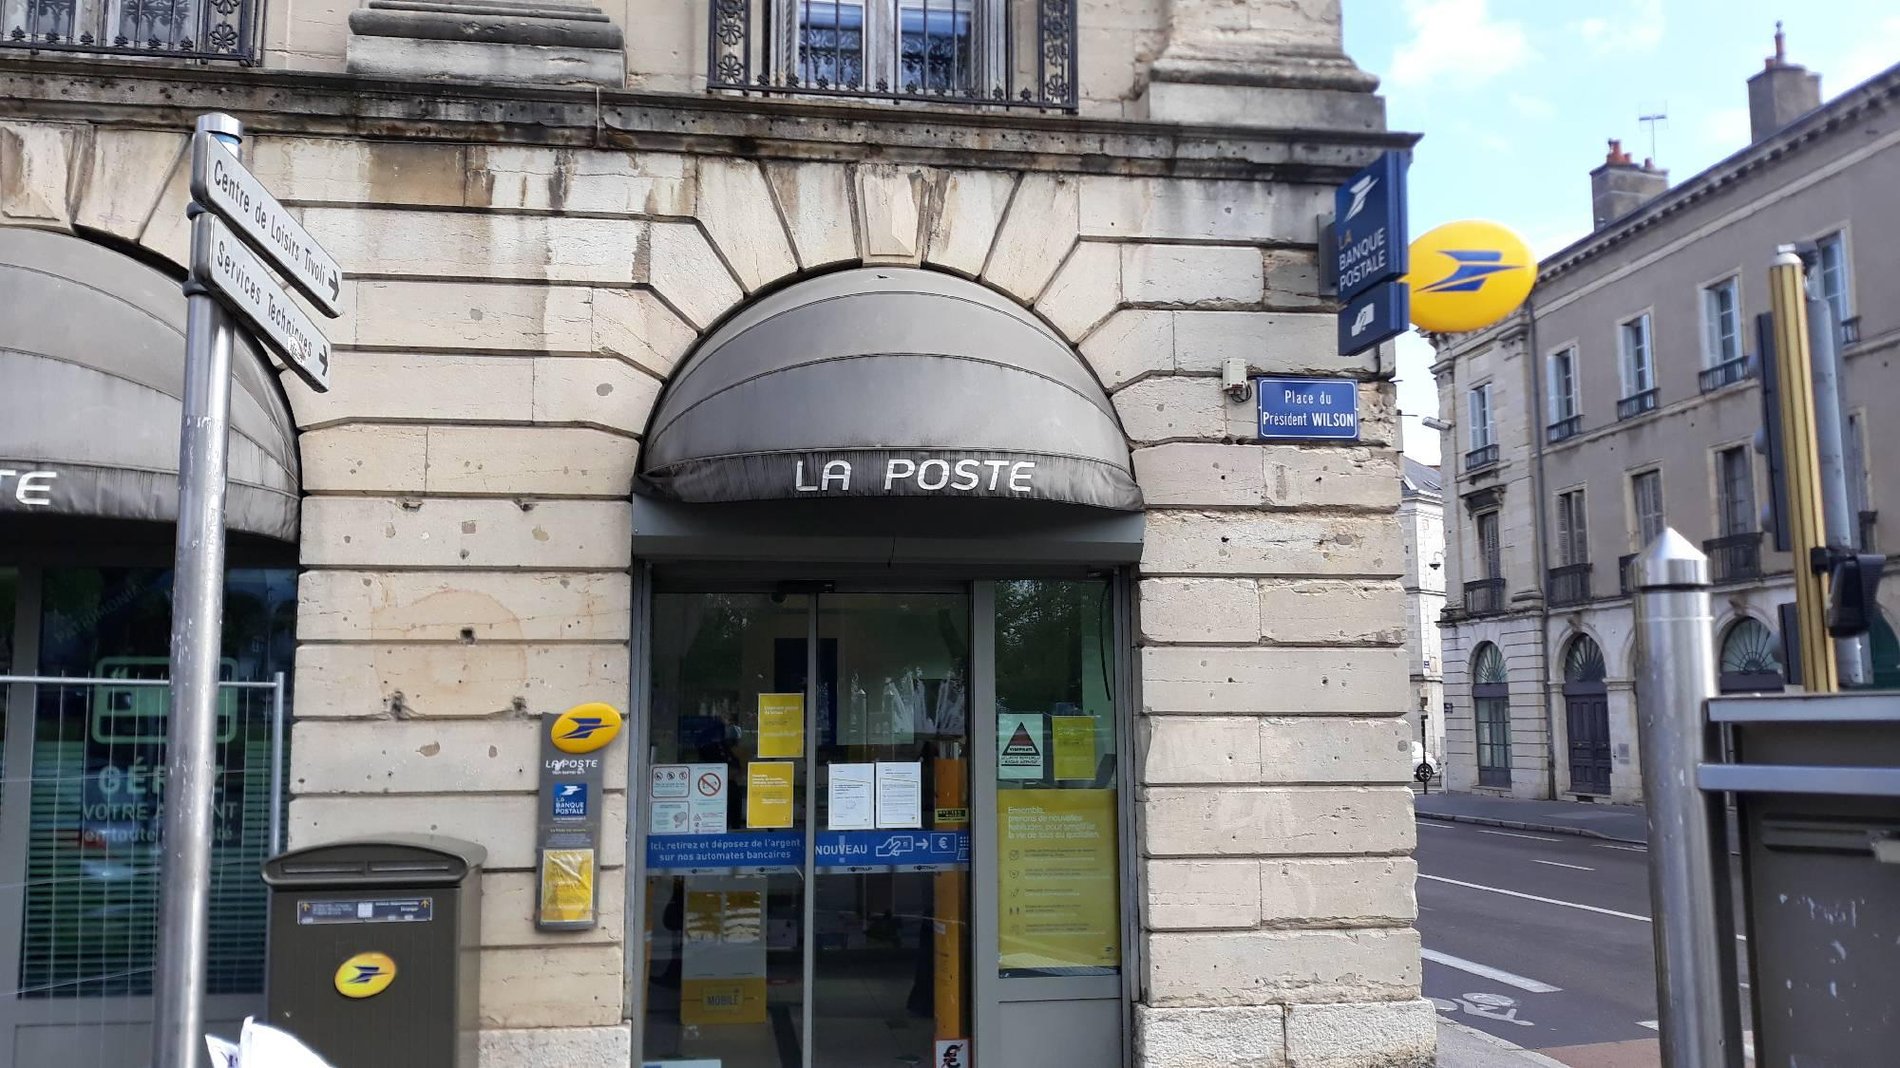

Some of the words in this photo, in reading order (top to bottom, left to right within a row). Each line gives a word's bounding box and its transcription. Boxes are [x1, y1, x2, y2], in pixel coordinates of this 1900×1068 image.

[214, 159, 250, 213] Centre
[255, 201, 267, 230] de
[271, 214, 300, 262] Loisirs
[304, 247, 326, 287] Tivoli
[1338, 229, 1353, 251] LA
[1339, 227, 1386, 272] BANQUE
[217, 240, 262, 305] Services
[1339, 249, 1387, 293] POSTALE
[1285, 389, 1314, 404] Place
[1320, 391, 1332, 405] du
[1263, 411, 1308, 426] Président
[1312, 412, 1354, 427] WILSON
[795, 459, 851, 492] LA
[884, 458, 1036, 492] POSTE
[561, 759, 598, 768] POSTE
[83, 803, 148, 820] VOTRE
[651, 842, 664, 850] Ici,
[667, 841, 698, 850] retirez
[700, 841, 709, 850] et
[711, 839, 749, 851] déposez
[751, 839, 763, 848] de
[764, 838, 801, 849] l'argent
[815, 844, 868, 856] NOUVEAU
[659, 854, 674, 862] sur
[677, 853, 694, 862] nos
[696, 851, 745, 860] automates
[746, 849, 791, 859] bancaires
